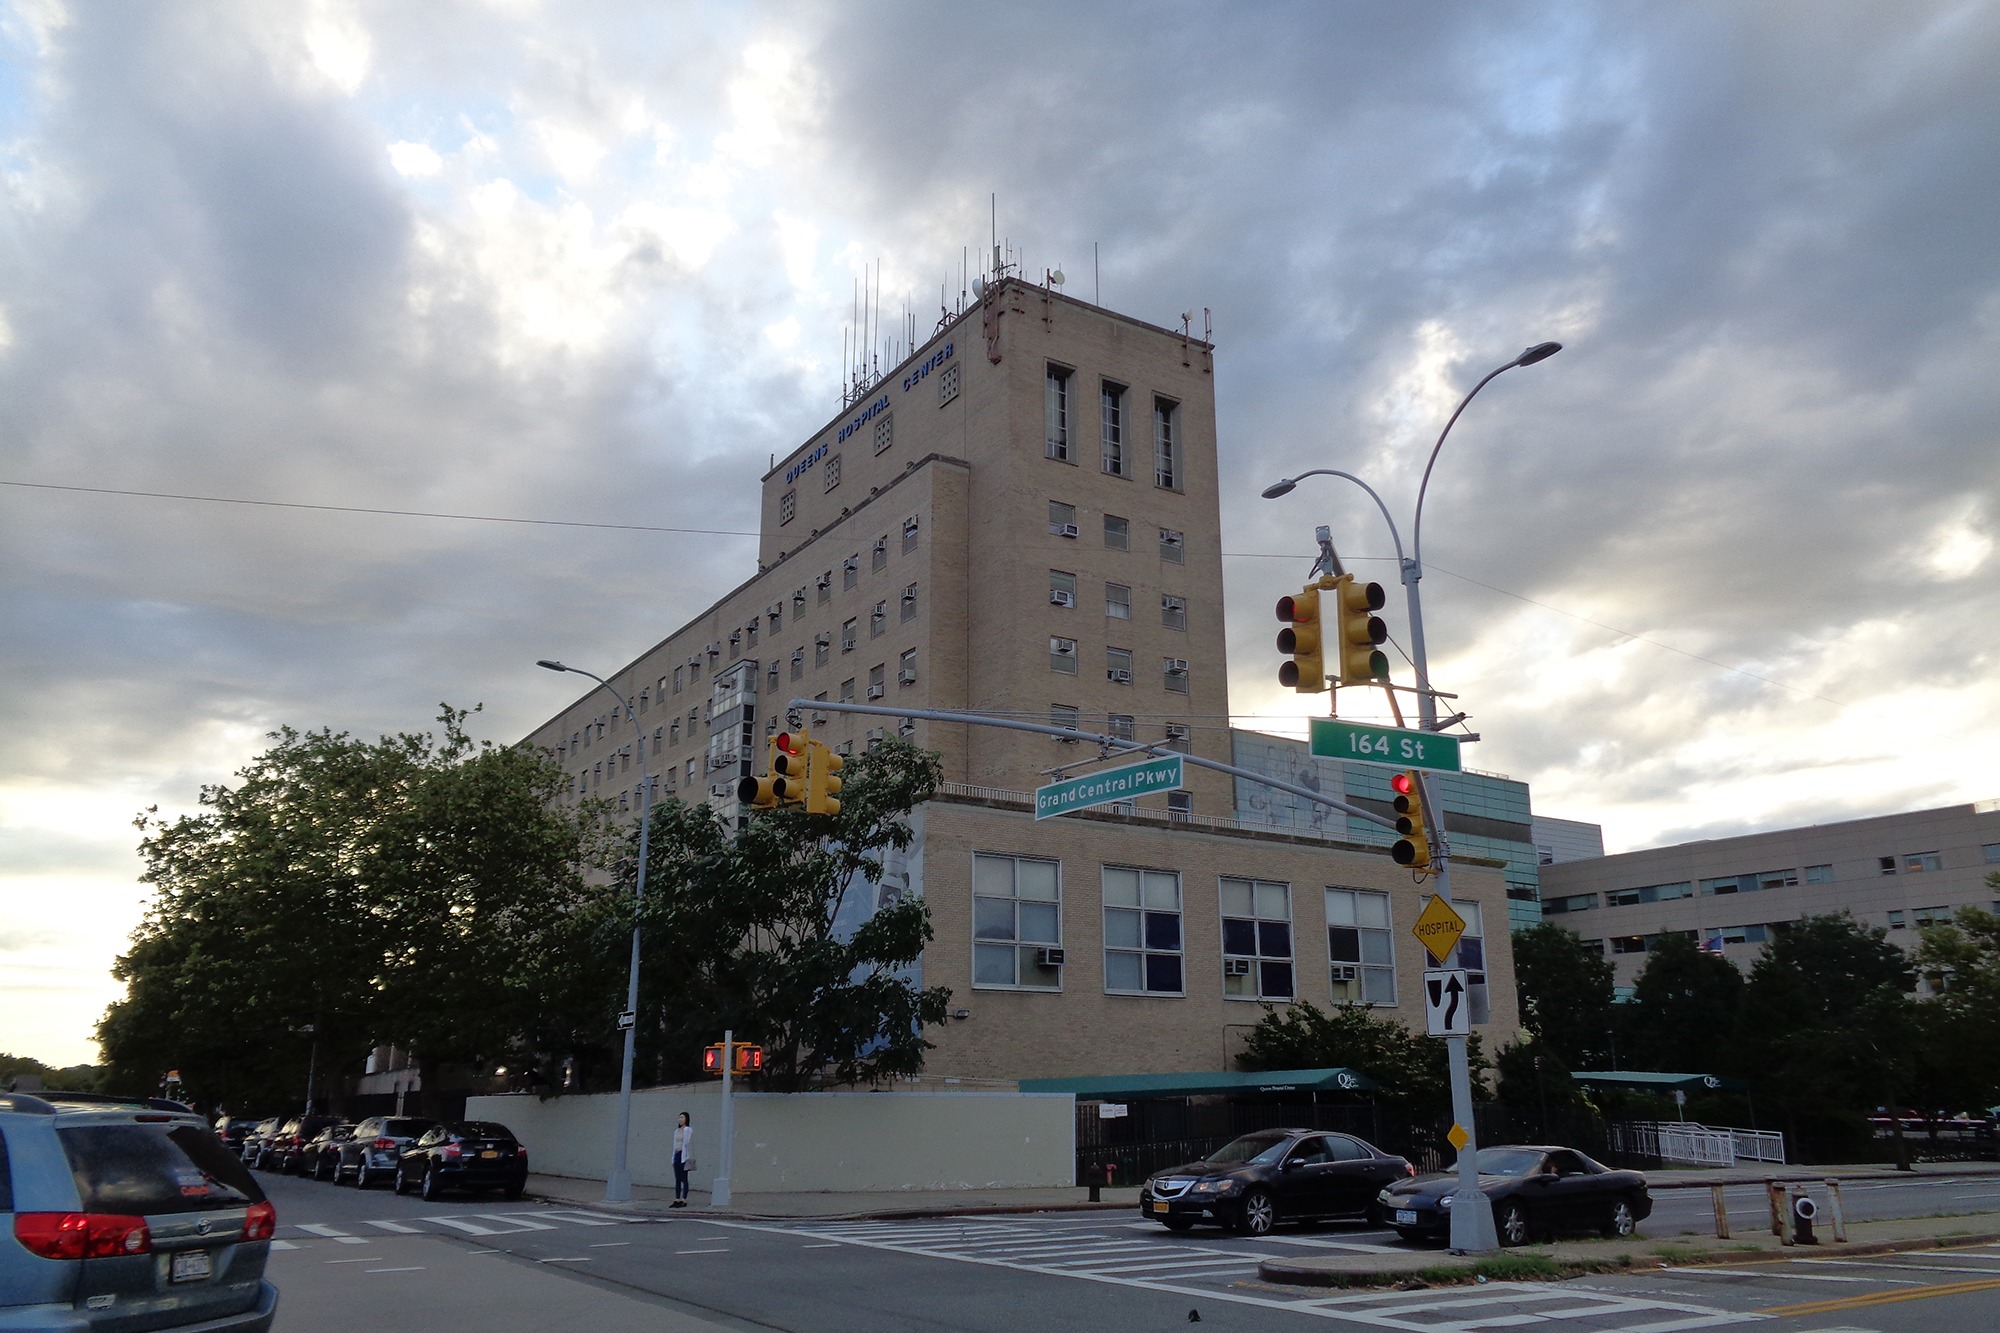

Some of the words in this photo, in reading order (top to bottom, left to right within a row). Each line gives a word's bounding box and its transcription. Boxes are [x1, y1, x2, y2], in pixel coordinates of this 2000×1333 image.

[786, 443, 828, 484] QUEENS
[838, 394, 890, 444] HOSPITAL
[903, 343, 954, 392] CENTER
[1349, 732, 1390, 755] 164
[1400, 738, 1425, 760] St
[1039, 787, 1076, 809] Grand
[1078, 774, 1132, 799] Central
[1135, 767, 1177, 787] Pkwy
[1418, 920, 1461, 936] HOSPITAL
